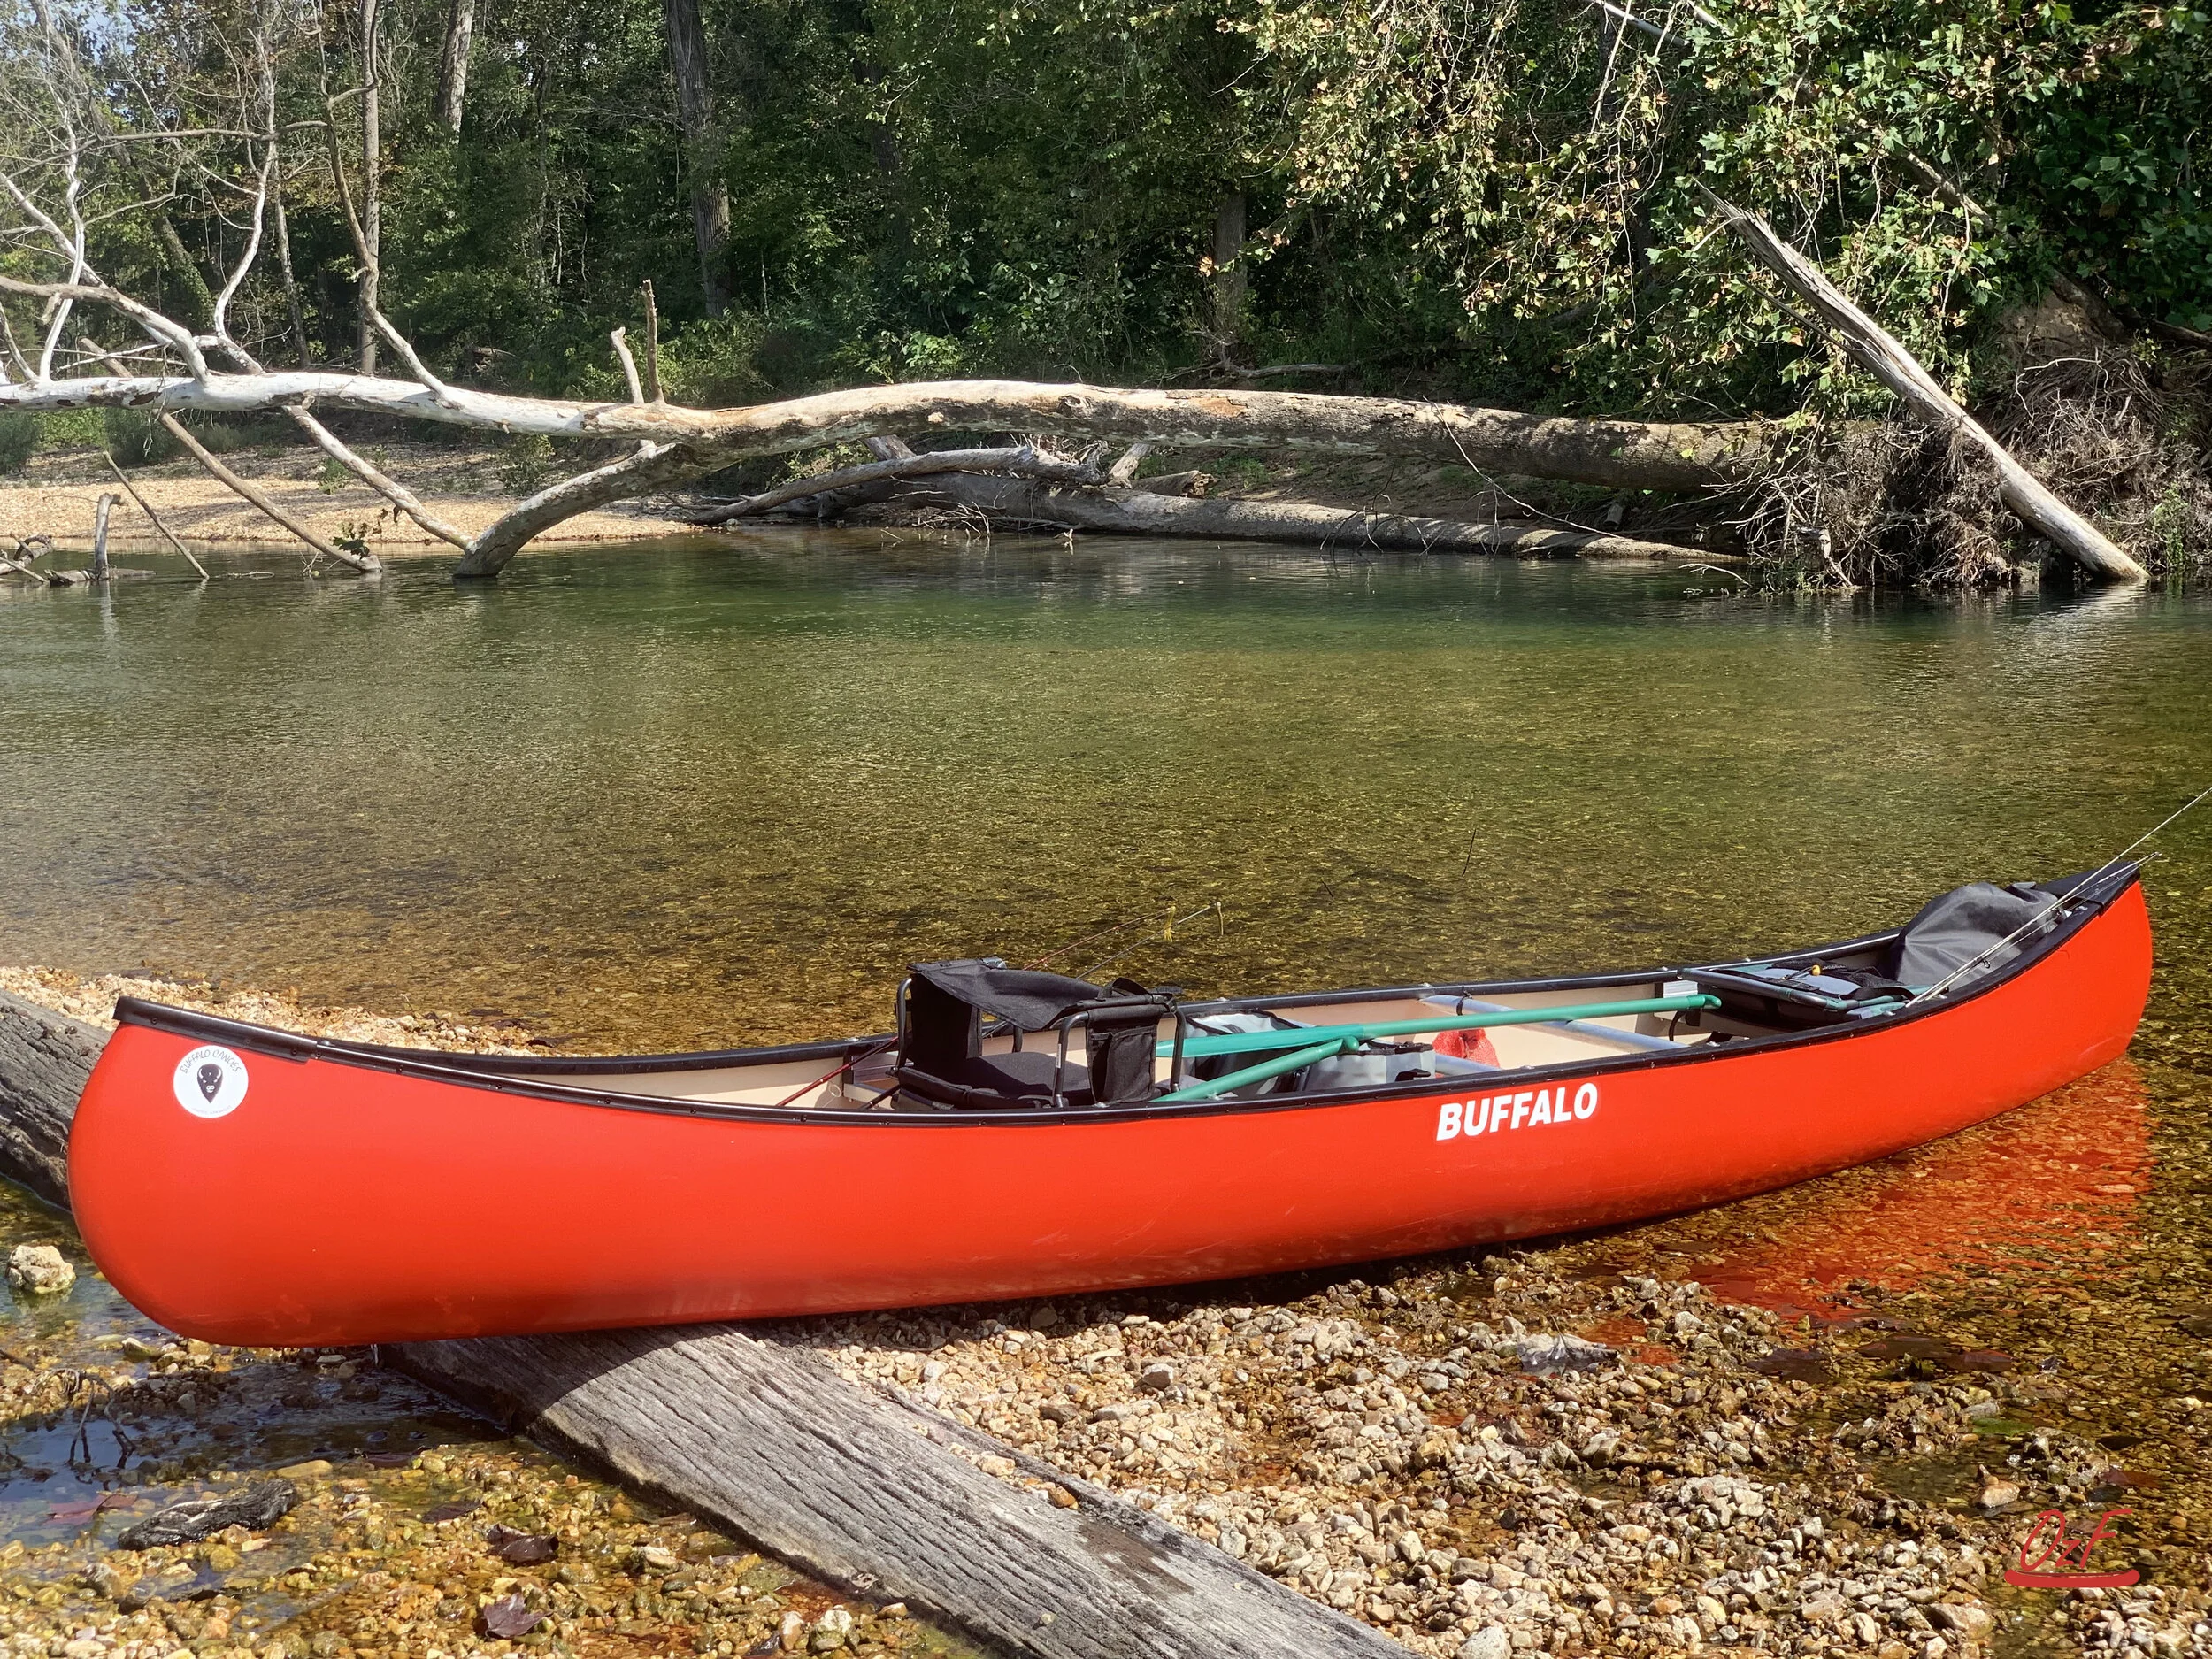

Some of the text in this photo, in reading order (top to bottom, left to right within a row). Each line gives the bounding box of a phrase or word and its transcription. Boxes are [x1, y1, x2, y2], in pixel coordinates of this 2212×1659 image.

[180, 1049, 242, 1074] BUFFALO CANOES
[1436, 1083, 1598, 1141] BUFFALO
